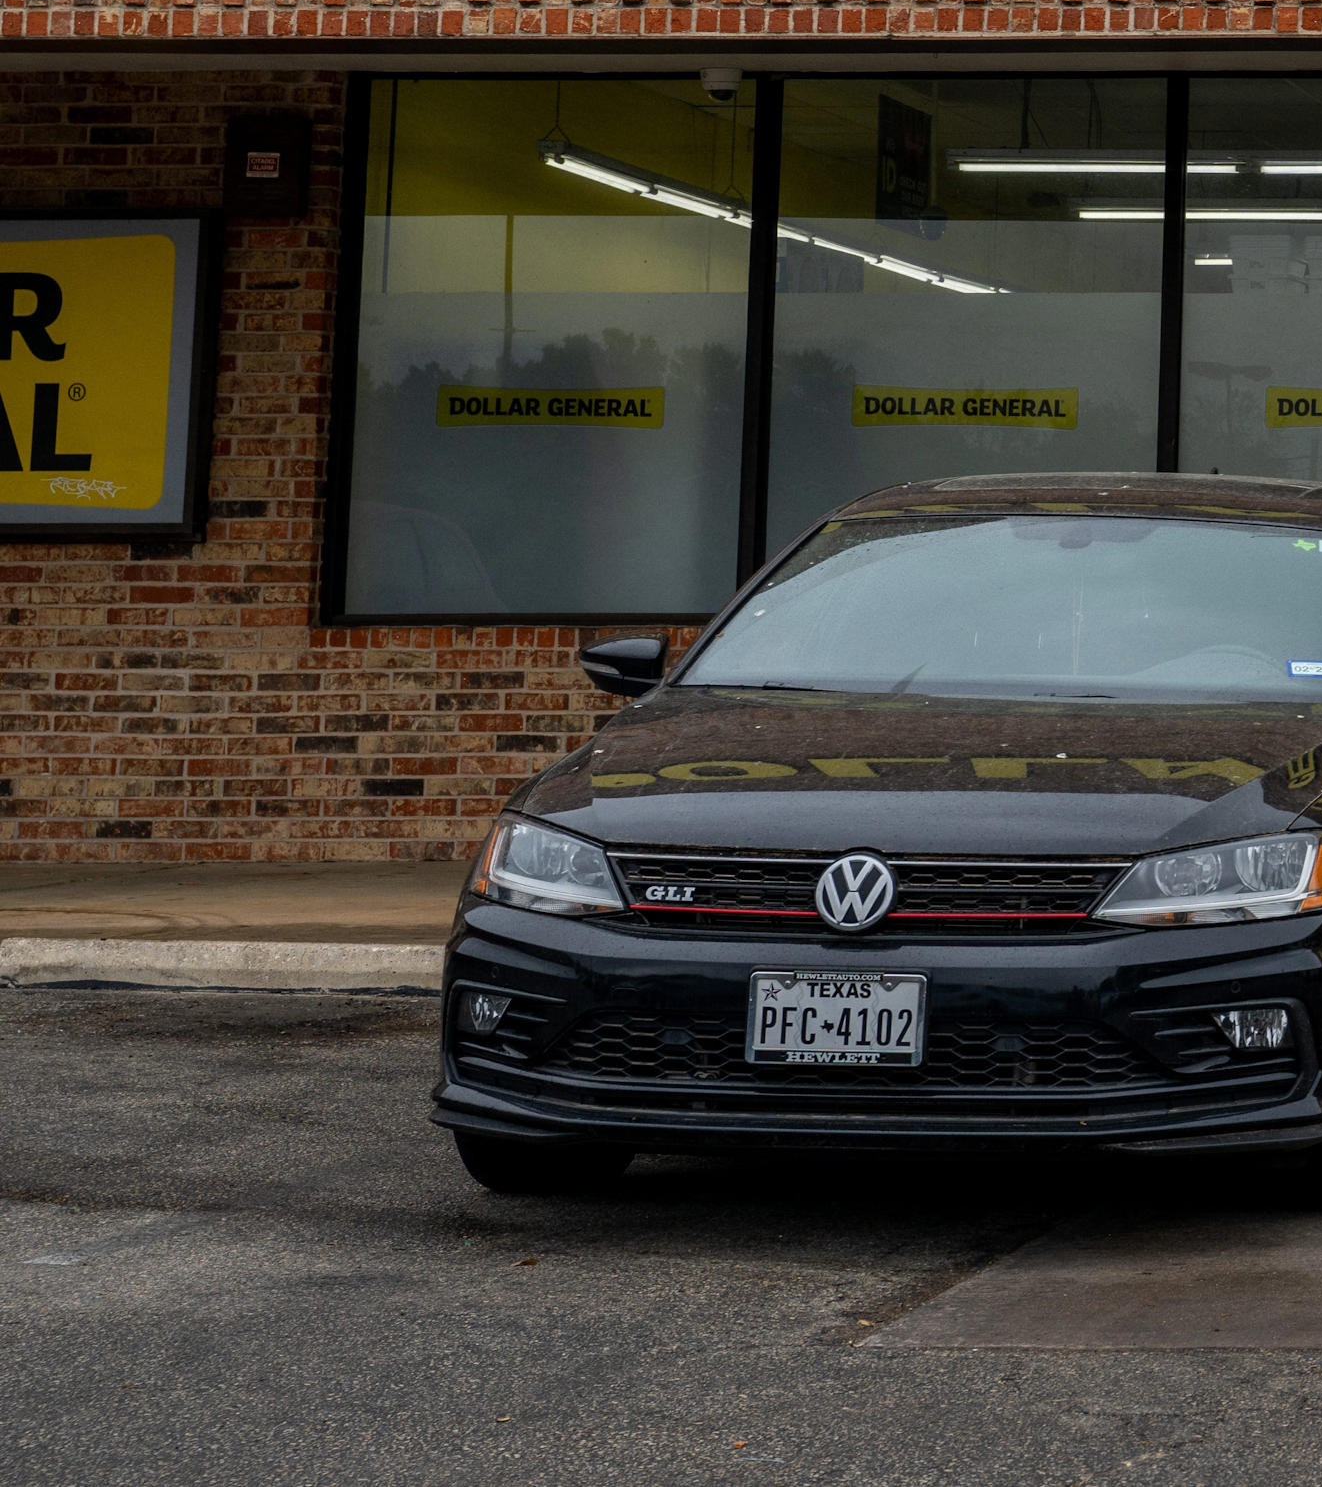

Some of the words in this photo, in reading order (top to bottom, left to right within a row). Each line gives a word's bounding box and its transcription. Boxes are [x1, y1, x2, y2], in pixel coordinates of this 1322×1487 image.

[449, 397, 540, 416] DOLLAR
[548, 398, 651, 417] GENERAL
[864, 397, 955, 416] DOLLAR
[962, 397, 1066, 417] GENERAL
[645, 885, 696, 902] GLI
[795, 973, 882, 981] HEWLETTAUTO.COM
[807, 982, 872, 999] TEXAS
[785, 1051, 882, 1064] HEWLETT
